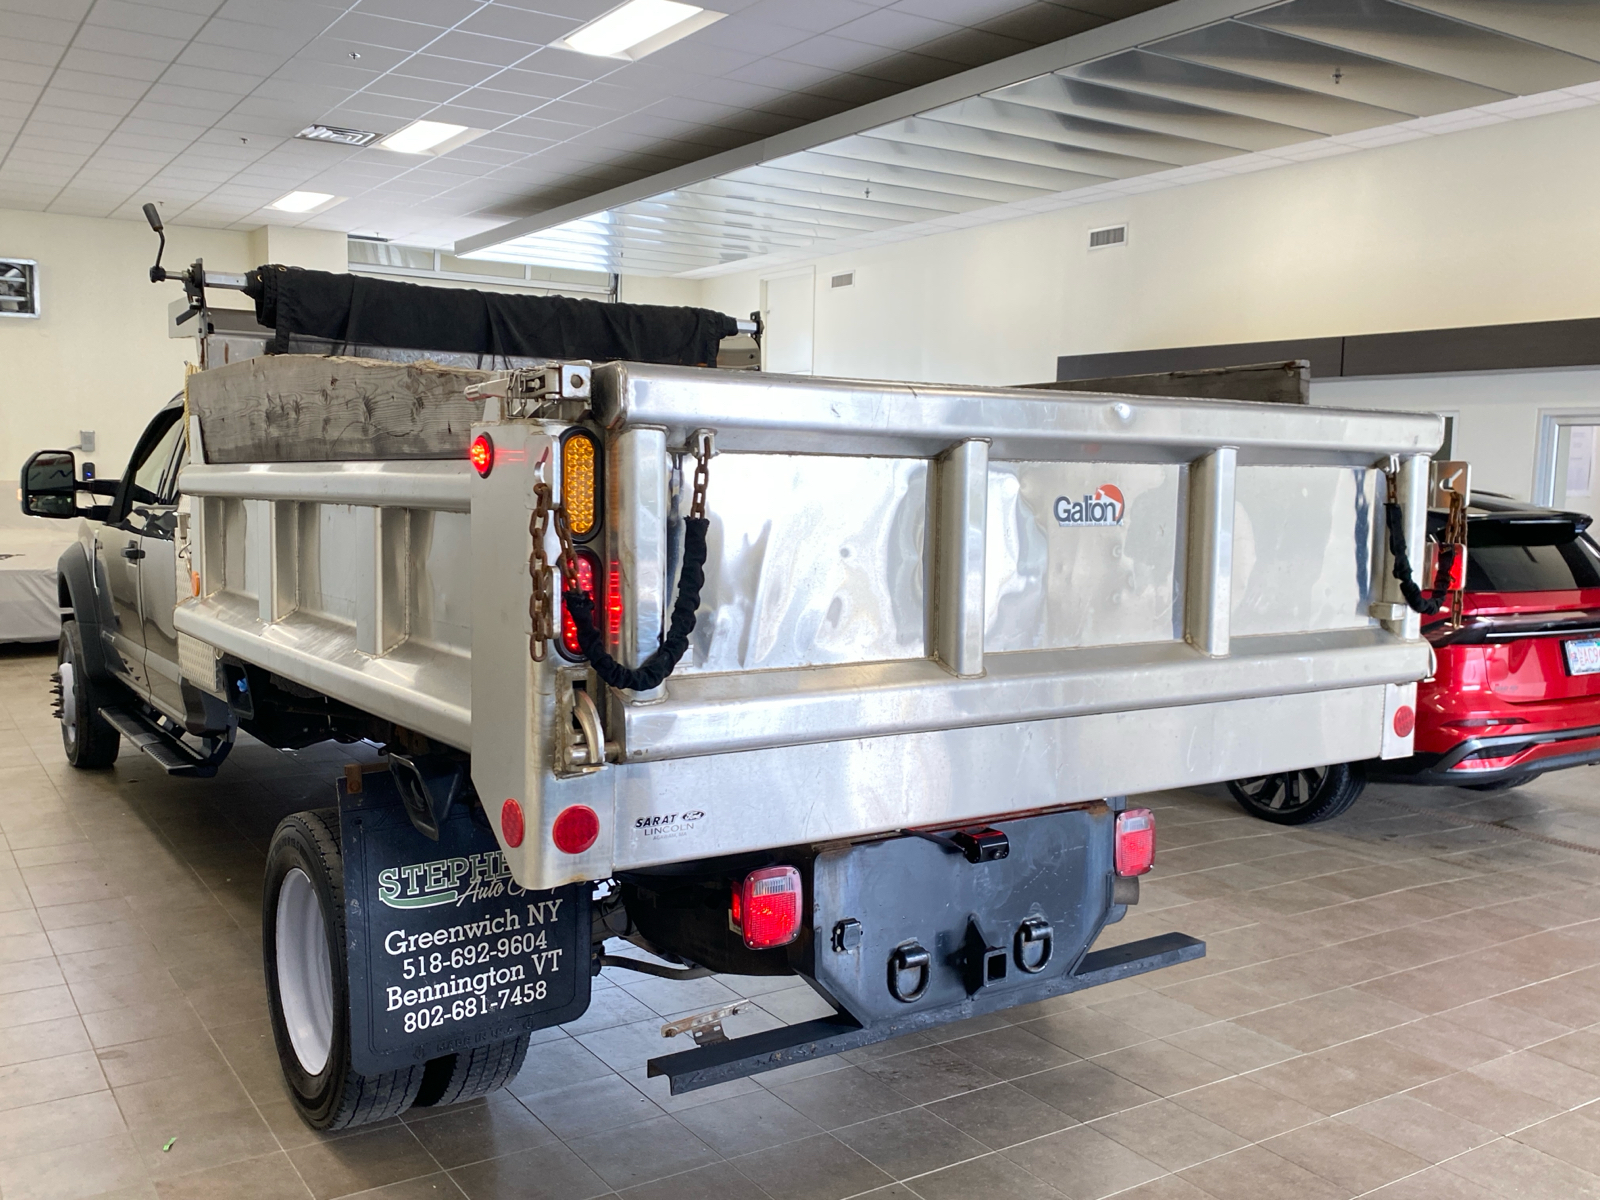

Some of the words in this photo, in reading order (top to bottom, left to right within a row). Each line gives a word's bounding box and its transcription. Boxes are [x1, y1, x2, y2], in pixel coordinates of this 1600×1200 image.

[1053, 494, 1117, 523] Galion
[635, 814, 677, 828] SARAT
[644, 823, 694, 836] LINCOLN
[378, 851, 512, 897] STEPHE
[456, 875, 505, 907] Auto
[384, 908, 521, 956] Greenwich
[526, 898, 564, 927] NY
[402, 929, 548, 980] 518-692-9604
[386, 963, 526, 1012] Bennington
[531, 949, 563, 976] VT
[403, 980, 548, 1034] 802-681-7458
